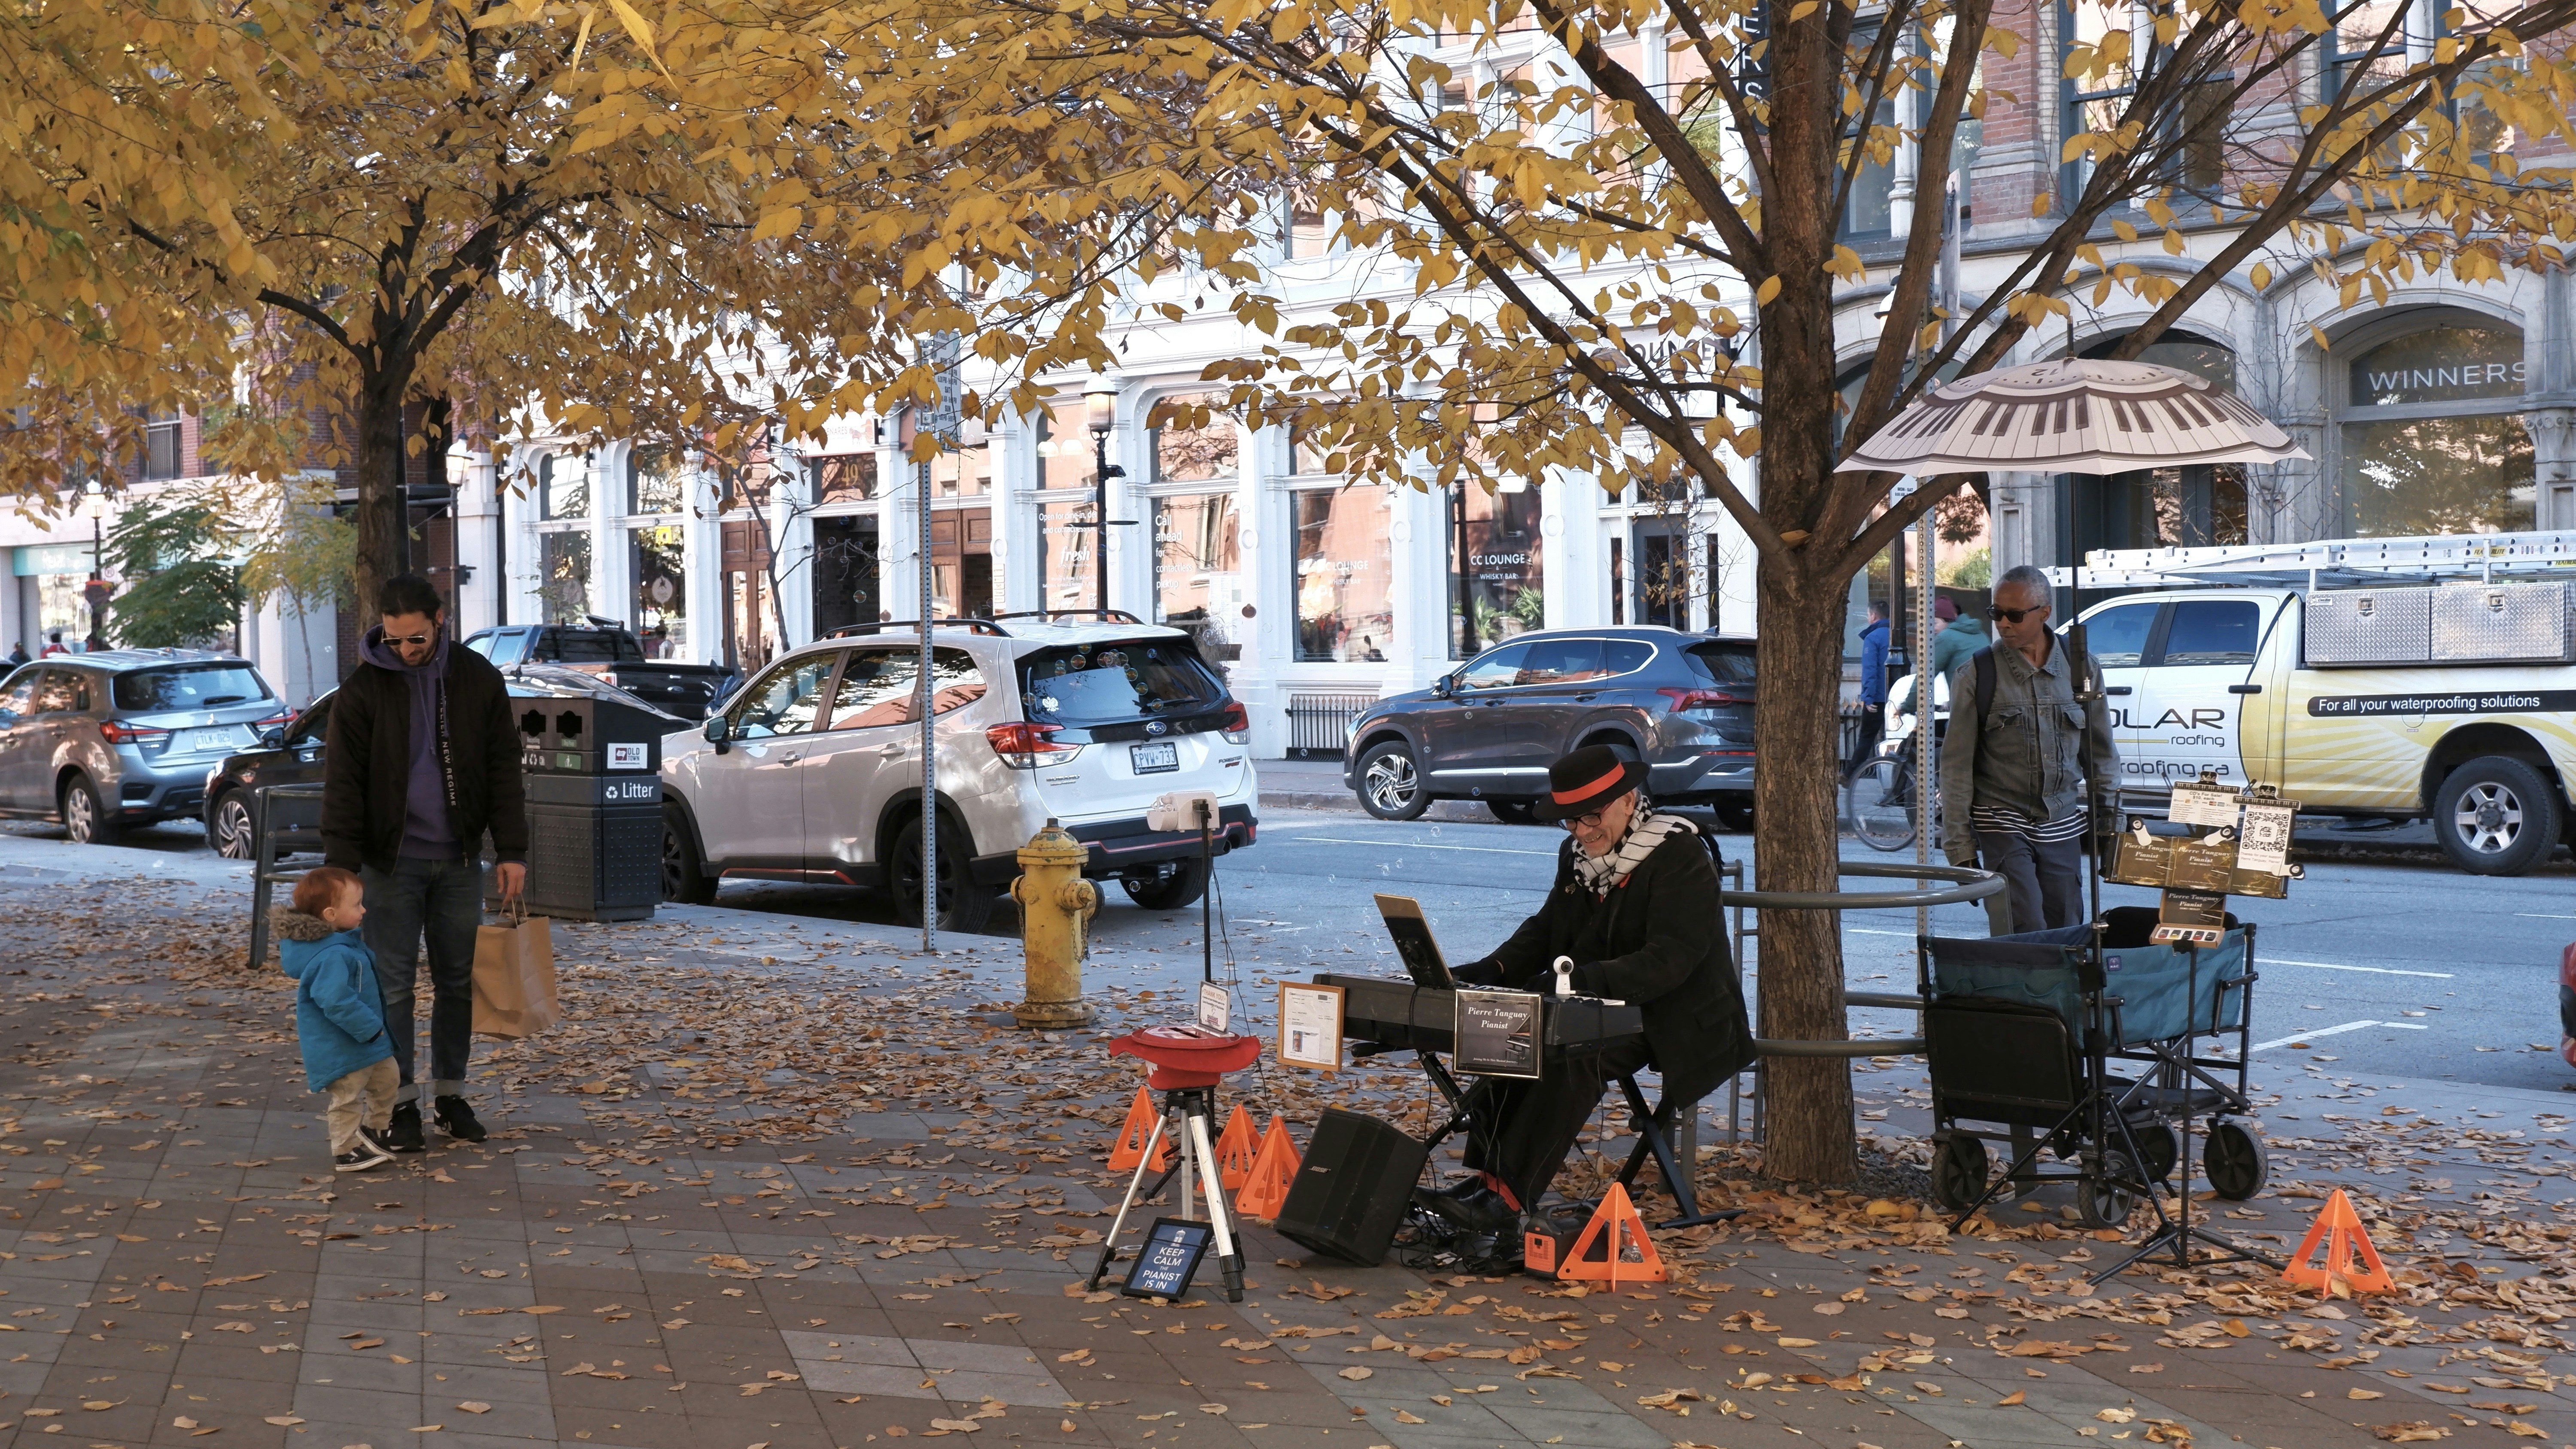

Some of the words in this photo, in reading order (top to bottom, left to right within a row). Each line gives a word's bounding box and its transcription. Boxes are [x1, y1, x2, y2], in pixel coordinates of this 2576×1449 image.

[2368, 361, 2525, 391] WINNERS
[826, 426, 848, 436] ENARES
[841, 463, 858, 486] 49
[1039, 513, 1054, 522] Open
[1155, 515, 1172, 526] Call
[1156, 530, 1182, 542] ahead
[1060, 546, 1091, 565] fresh
[1156, 548, 1166, 557] for
[1470, 555, 1482, 565] CC
[1485, 554, 1525, 565] LOUNGE
[1156, 563, 1193, 573] contactless
[1333, 560, 1369, 571] LOUNGE
[1156, 579, 1179, 591] pickup
[2319, 699, 2339, 711] For
[2343, 698, 2356, 710] all
[2360, 700, 2388, 713] your
[2391, 696, 2476, 712] waterproofing
[2481, 695, 2540, 707] solutions
[2171, 735, 2225, 747] roofing
[441, 742, 451, 764] NEW
[1134, 752, 1156, 767] CPVW
[1159, 750, 1176, 764] 733
[446, 768, 456, 806] REGIME
[623, 782, 654, 798] Litter
[2202, 849, 2231, 857] Tanguay
[1203, 988, 1215, 998] THANK
[1468, 1006, 1492, 1016] Pierre
[1494, 1008, 1528, 1020] Tanguay
[1481, 1020, 1508, 1029] Pianist
[1159, 1247, 1185, 1257] KEEP
[1153, 1256, 1182, 1266] CALM
[1142, 1270, 1182, 1281] PIANIST
[1144, 1279, 1154, 1288] IS
[1155, 1281, 1167, 1290] IN
